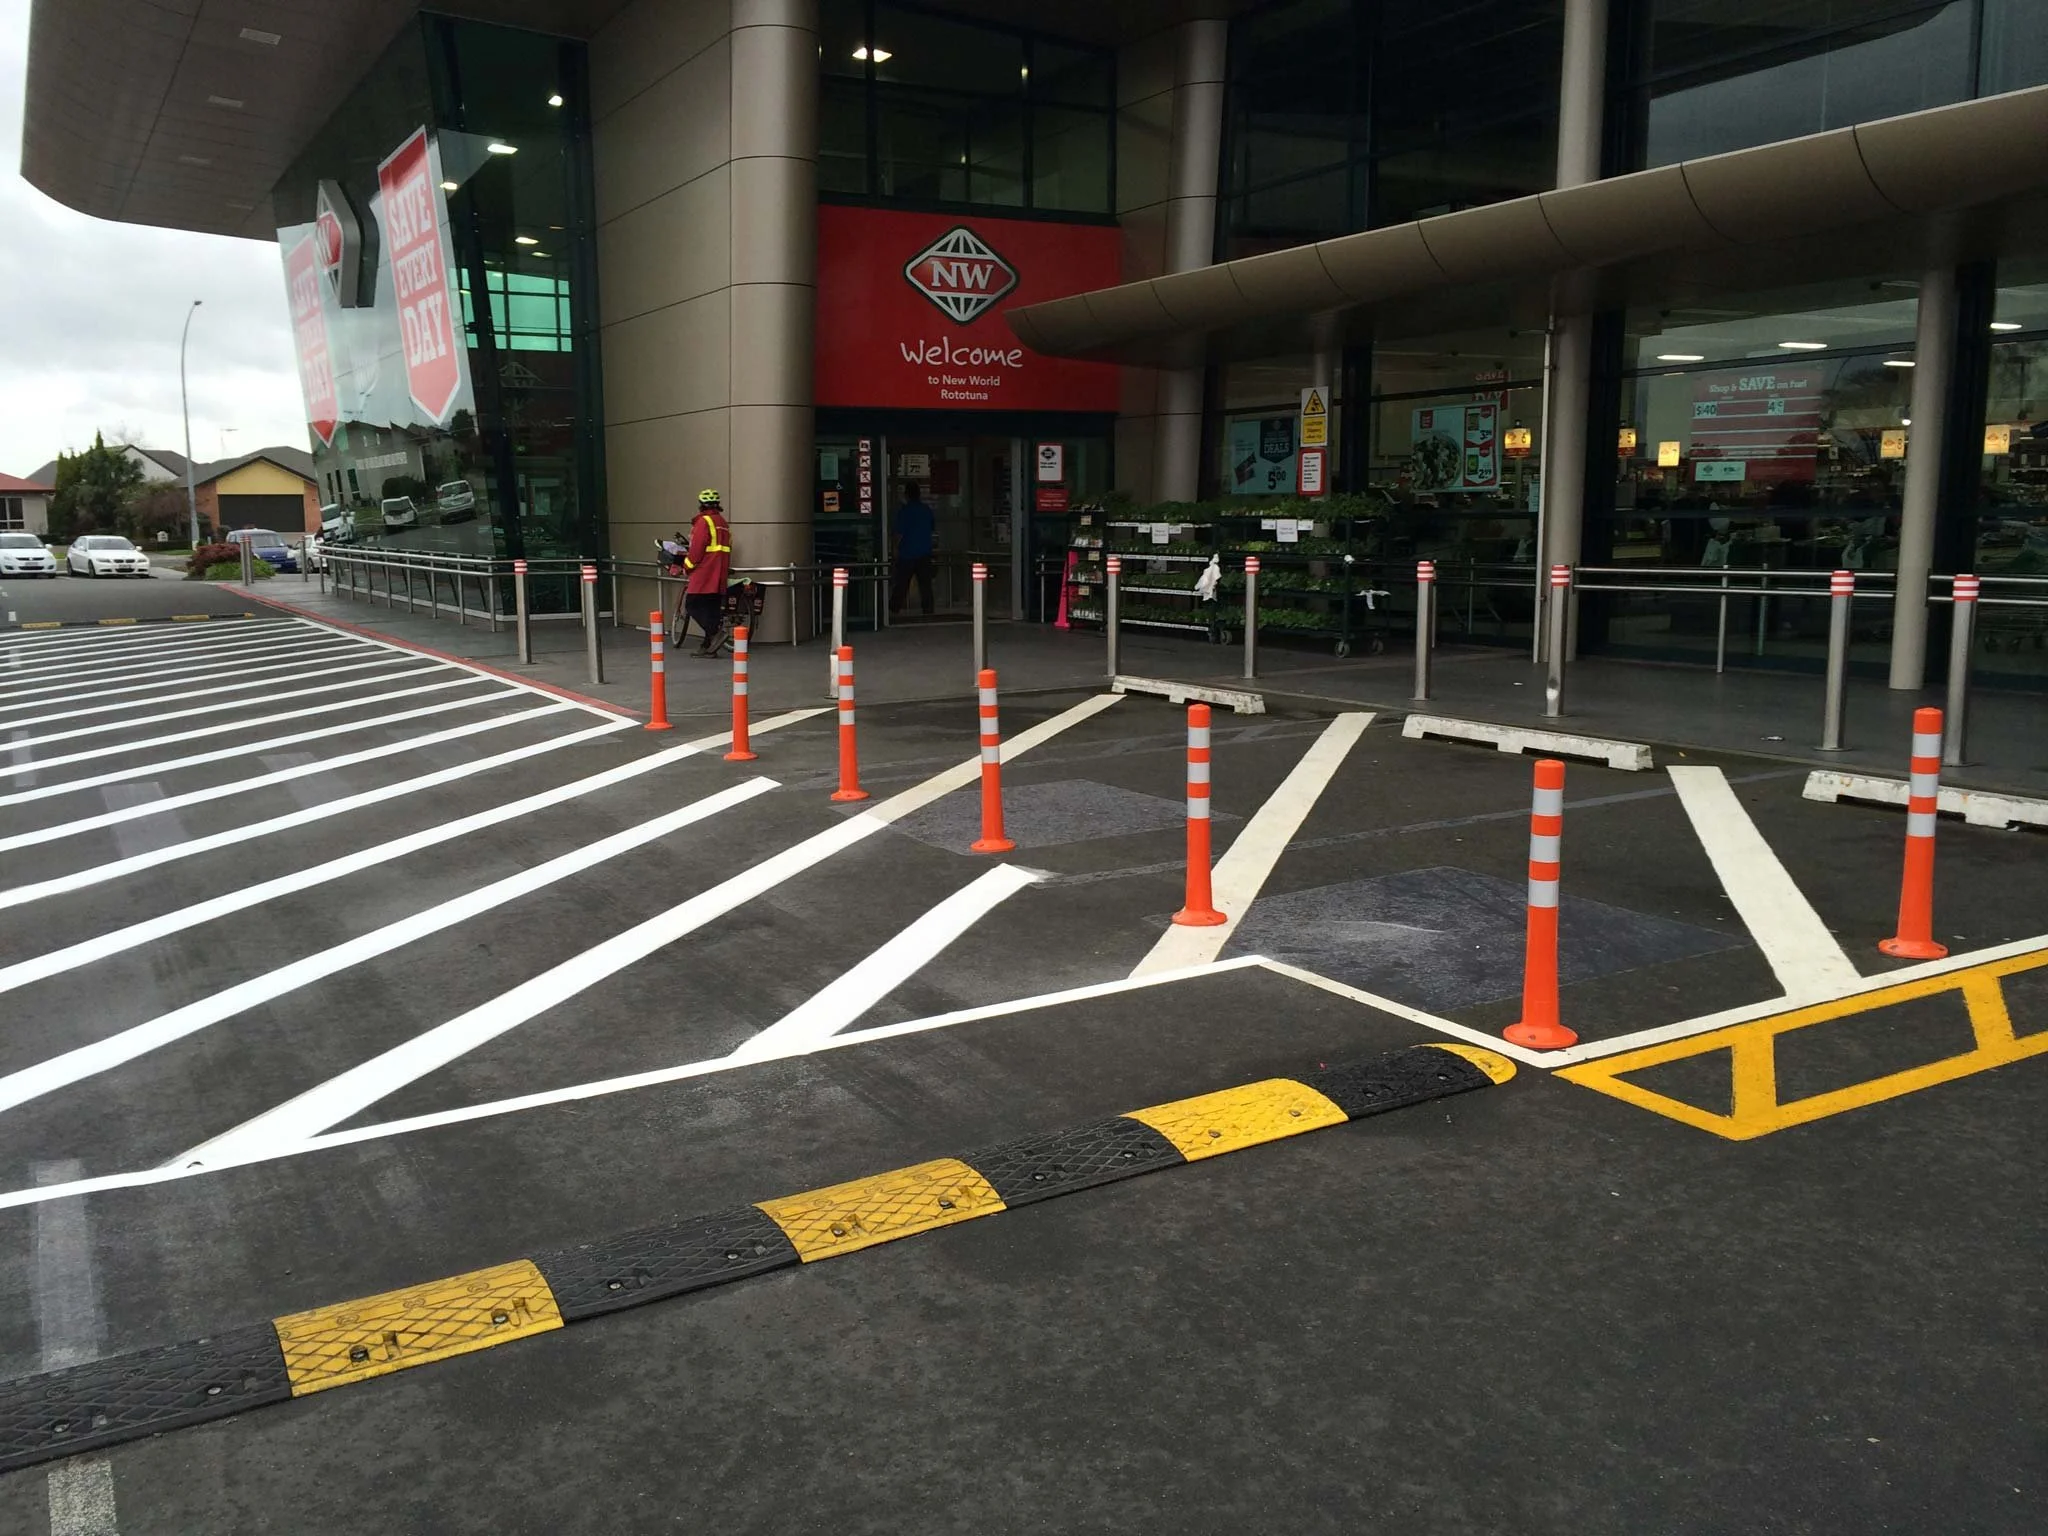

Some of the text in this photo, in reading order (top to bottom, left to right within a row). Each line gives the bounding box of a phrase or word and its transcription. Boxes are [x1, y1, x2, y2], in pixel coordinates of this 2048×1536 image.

[389, 172, 433, 252] SAVE
[396, 239, 439, 299] EVERY
[931, 260, 994, 290] NW
[403, 291, 448, 368] DAY
[900, 336, 1024, 368] Welcome
[928, 375, 1000, 386] to New World
[941, 389, 988, 401] Rototuna
[1739, 376, 1775, 391] SAVE
